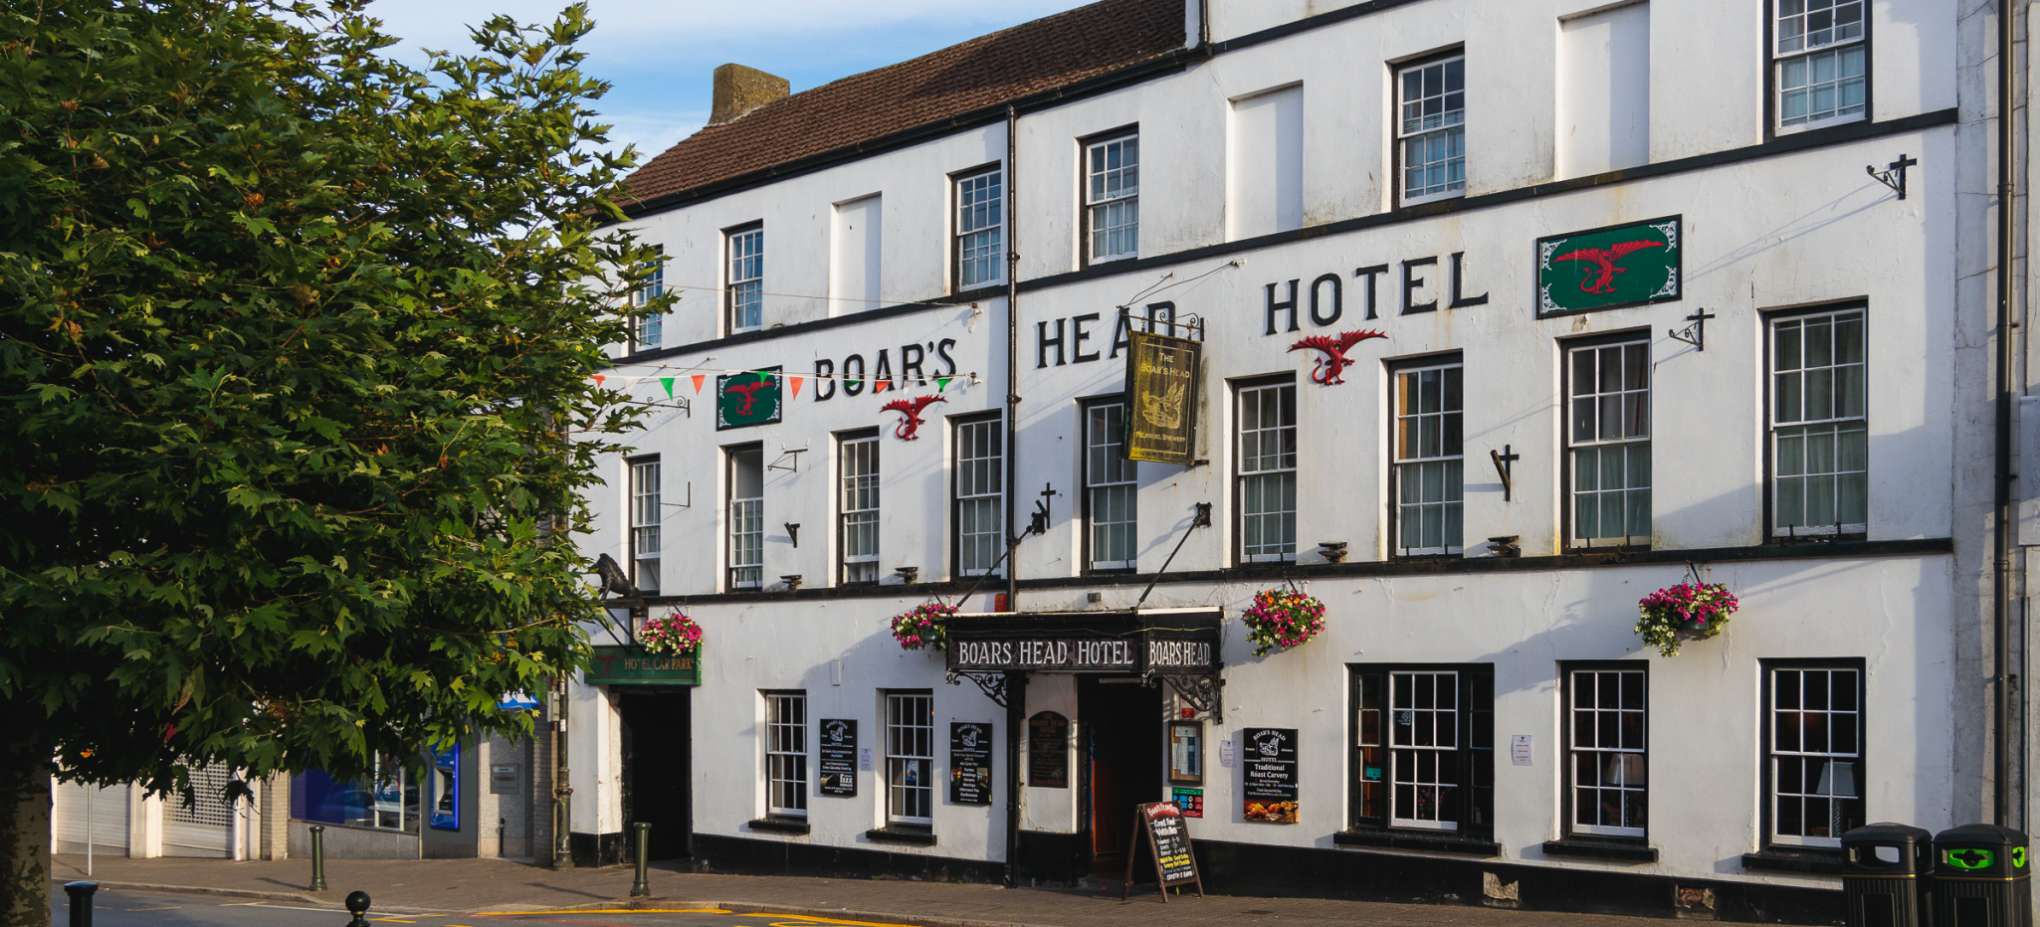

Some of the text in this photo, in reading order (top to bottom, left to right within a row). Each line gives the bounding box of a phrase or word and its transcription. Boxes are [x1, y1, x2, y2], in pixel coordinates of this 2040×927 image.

[815, 251, 1489, 402] BOAR'S HEAD HOTEL
[1159, 352, 1175, 363] THE
[958, 640, 1135, 665] BOARS HEAD HOTEL
[1150, 639, 1210, 666] BOARS HEAD
[1254, 763, 1285, 771] Traditional
[1266, 771, 1288, 779] Carvery
